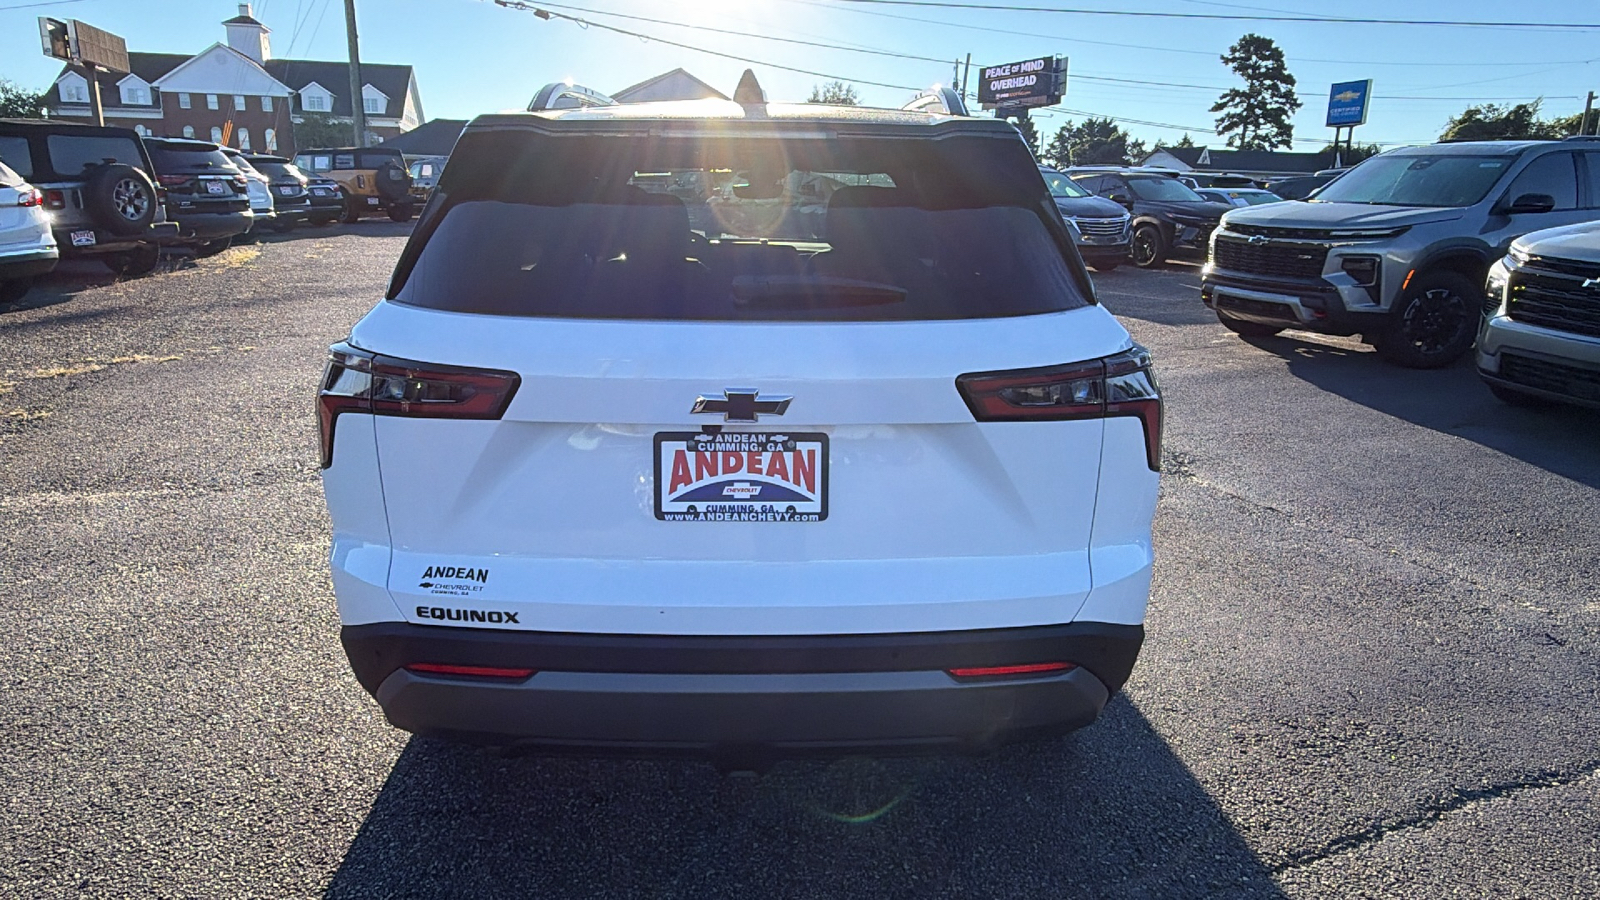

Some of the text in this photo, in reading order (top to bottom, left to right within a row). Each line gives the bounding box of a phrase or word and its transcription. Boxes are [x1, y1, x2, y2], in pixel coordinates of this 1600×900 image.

[985, 65, 1010, 78] PEACE
[1020, 59, 1044, 73] MIND
[990, 75, 1036, 90] OVERHEAD
[715, 434, 767, 443] ANDEAN
[697, 442, 784, 452] CUMMING, GA
[668, 449, 816, 496] ANDEAN
[664, 512, 819, 521] www.ANDEANCHEVY.com
[421, 566, 488, 583] ANDEAN
[433, 583, 484, 592] CHEVROLET
[416, 606, 520, 623] EQUINOX
